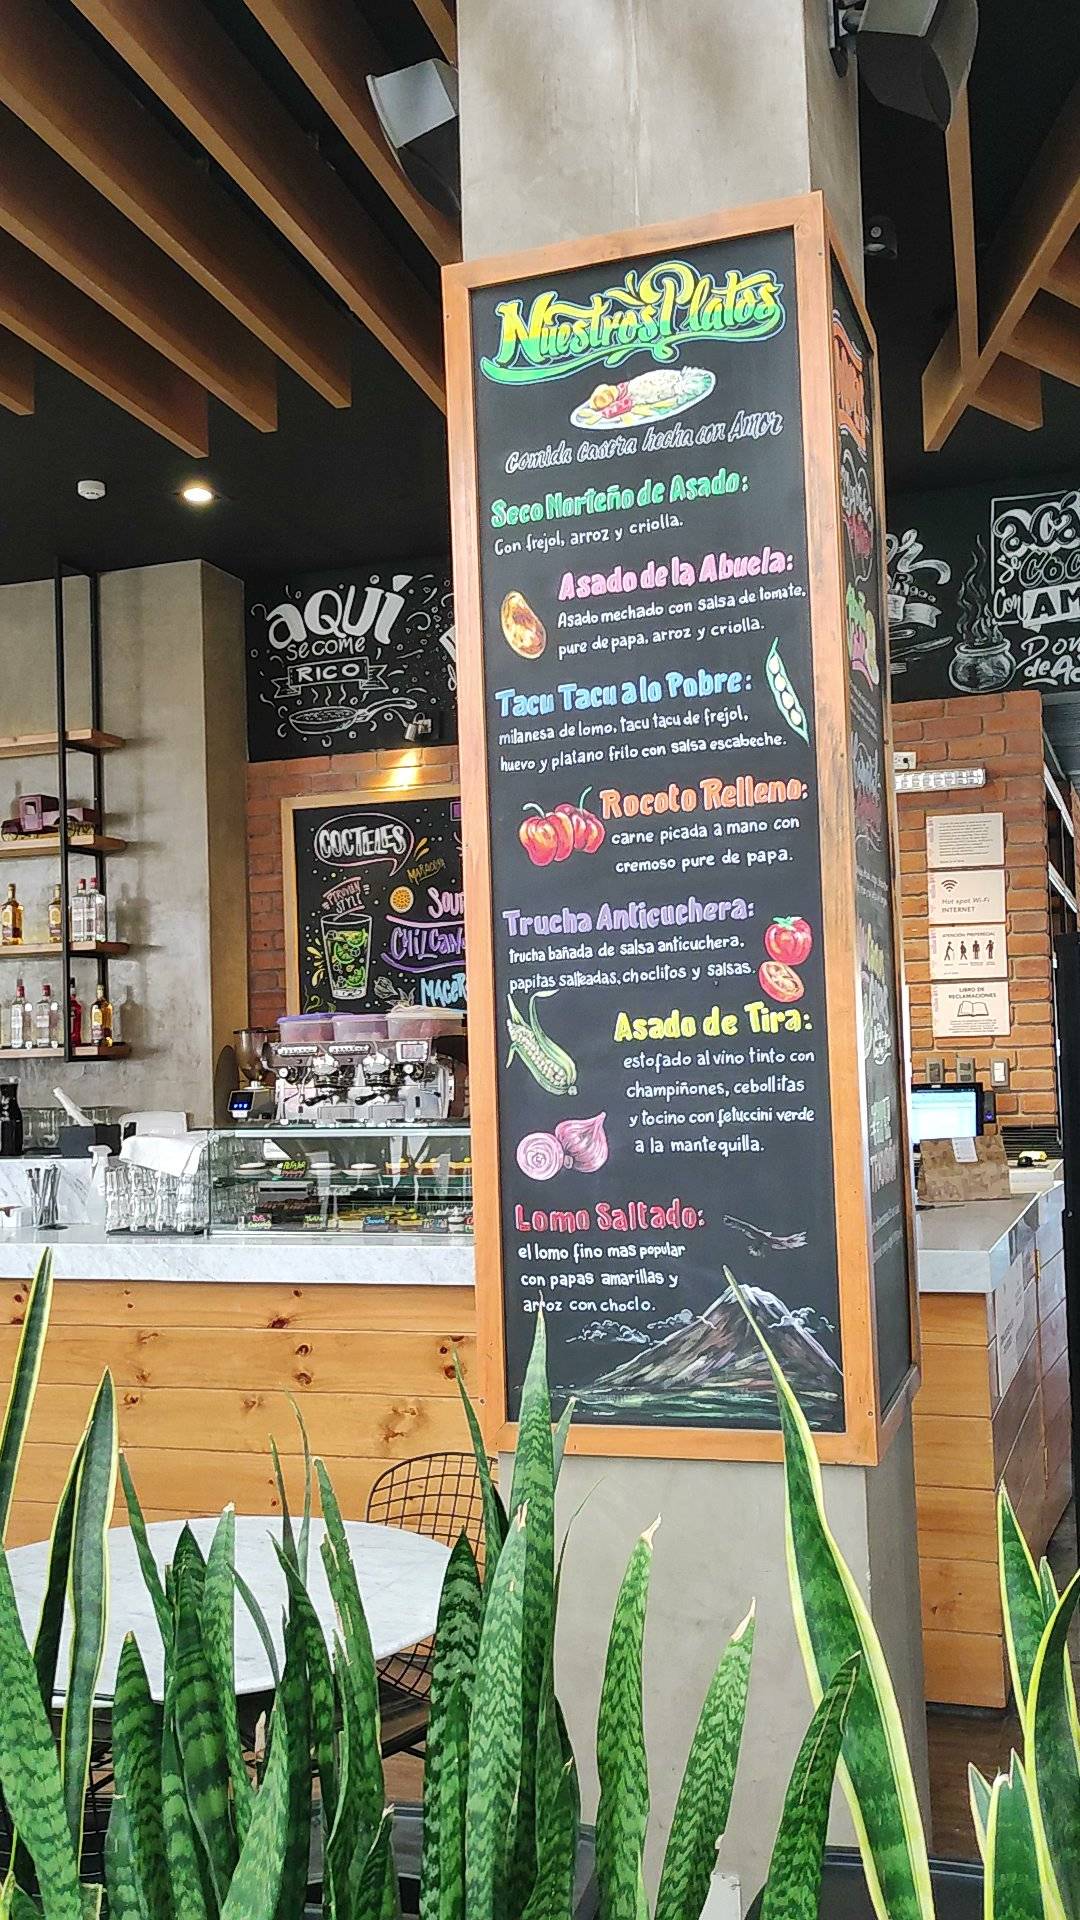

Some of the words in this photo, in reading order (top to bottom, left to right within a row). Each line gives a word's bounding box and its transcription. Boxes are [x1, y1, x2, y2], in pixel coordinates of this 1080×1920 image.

[486, 290, 659, 374] Nuestros
[634, 260, 785, 355] Platos
[504, 440, 573, 474] Comida
[576, 435, 637, 463] casera
[641, 423, 693, 451] hecha
[695, 423, 725, 445] con
[491, 499, 544, 528] Seco
[546, 484, 634, 520] Norteño
[636, 479, 665, 506] de
[669, 468, 750, 500] Asado:
[494, 538, 521, 556] Con
[526, 530, 565, 553] frejol,
[570, 524, 609, 542] arroz
[615, 527, 623, 541] y
[629, 514, 684, 535] criolla.
[558, 565, 638, 601] Asado
[640, 560, 667, 589] de
[671, 556, 695, 586] la
[698, 546, 794, 583] Abuela:
[557, 609, 599, 628] Asado
[601, 601, 664, 625] mechado
[668, 600, 693, 615] con
[698, 594, 735, 611] salsa
[738, 591, 756, 605] de
[759, 585, 807, 601] tomate.
[287, 641, 310, 661] se
[558, 643, 588, 660] pure
[592, 634, 608, 650] de
[611, 635, 649, 653] papa,
[652, 627, 692, 644] arroz
[696, 627, 706, 642] y
[710, 617, 765, 637] criolla.
[296, 664, 360, 682] RICO
[494, 688, 555, 718] Tacu
[558, 681, 618, 711] Tacu
[621, 681, 638, 706] a
[639, 675, 662, 703] lo
[665, 668, 752, 700] Pobre:
[498, 725, 555, 746] milanesa
[559, 721, 575, 738] de
[578, 719, 617, 737] lomo,
[620, 716, 650, 733] tacu
[653, 711, 682, 729] tacu
[684, 708, 700, 724] de
[704, 704, 749, 729] frejol,
[500, 755, 535, 772] huevo
[539, 757, 548, 773] y
[551, 747, 604, 772] platano
[609, 743, 638, 762] frito
[642, 742, 667, 758] con
[671, 737, 707, 754] salsa
[710, 731, 787, 750] escabeche.
[599, 783, 697, 820] Rocoto
[700, 775, 809, 810] Relleno:
[318, 824, 407, 859] COCTELES
[611, 830, 654, 845] carne
[660, 823, 708, 844] picada
[714, 822, 722, 836] a
[726, 821, 768, 835] mano
[773, 816, 800, 830] con
[615, 859, 676, 874] cremoso
[681, 853, 715, 872] pure
[722, 849, 741, 865] de
[747, 848, 793, 866] papa.
[502, 907, 592, 937] Trucha
[596, 896, 754, 930] Anticuchera:
[508, 947, 546, 964] trucha
[548, 944, 593, 961] bañada
[598, 942, 615, 958] de
[620, 939, 654, 956] salsa
[510, 973, 556, 994] papitas
[622, 967, 687, 984] choclitos
[692, 967, 700, 981] y
[707, 962, 756, 977] salsas.
[614, 1010, 697, 1042] Asado
[702, 1006, 738, 1037] de
[744, 1001, 813, 1034] Tira:
[624, 1050, 692, 1073] estofado
[697, 1048, 710, 1065] al
[713, 1048, 744, 1065] vino
[749, 1047, 786, 1064] tinto
[789, 1049, 815, 1064] con
[626, 1081, 730, 1103] champiñones,
[733, 1076, 805, 1093] cebollitas
[629, 1115, 638, 1128] y
[641, 1109, 686, 1126] tocino
[689, 1112, 715, 1125] con
[718, 1107, 773, 1127] fetuccini
[776, 1107, 815, 1122] verde
[635, 1139, 645, 1153] a
[650, 1136, 664, 1152] la
[671, 1134, 764, 1156] mantequilla.
[514, 1203, 590, 1233] Lomo
[595, 1198, 705, 1232] Saltado:
[518, 1246, 532, 1260] el
[535, 1244, 569, 1260] lomo
[573, 1242, 602, 1263] fino
[608, 1242, 637, 1258] mas
[639, 1241, 685, 1259] popular
[521, 1273, 545, 1286] con
[550, 1273, 594, 1287] papas
[600, 1268, 664, 1286] amarillas
[669, 1273, 678, 1287] y
[570, 1298, 596, 1312] con
[600, 1298, 655, 1312] choclo.
